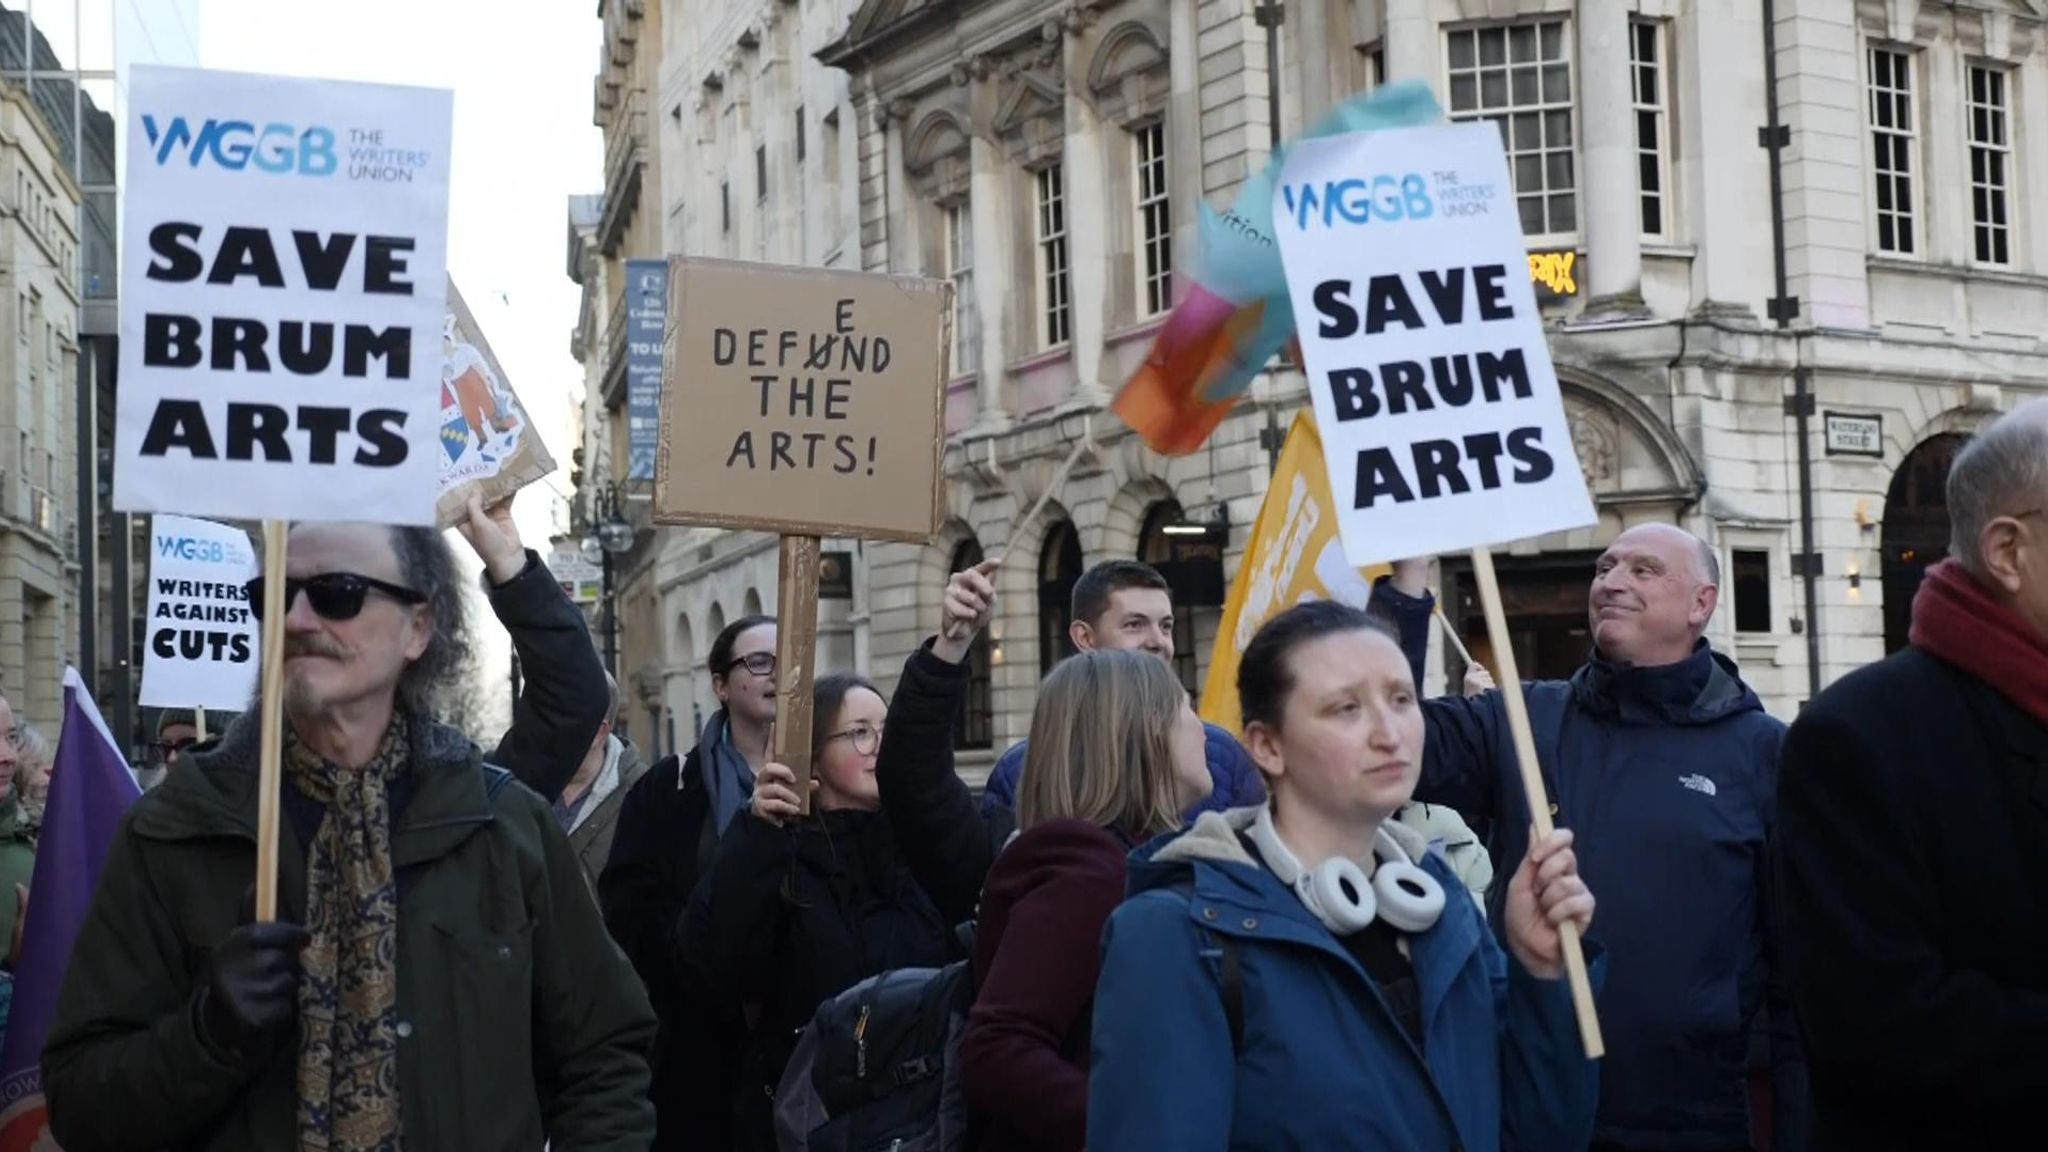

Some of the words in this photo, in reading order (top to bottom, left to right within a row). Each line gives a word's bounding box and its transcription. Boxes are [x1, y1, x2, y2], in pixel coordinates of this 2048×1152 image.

[141, 115, 338, 176] WGGB
[350, 129, 384, 146] THE
[349, 166, 413, 183] UNION
[1433, 171, 1457, 186] THE
[1284, 173, 1433, 230] WGGB
[1441, 200, 1488, 217] UNION
[146, 221, 415, 296] SAVE
[1312, 264, 1514, 339] SAVE
[143, 313, 411, 379] BRUM
[750, 376, 851, 419] THE
[1327, 348, 1533, 422] BRUM
[139, 398, 410, 468] ARTS
[726, 431, 876, 476] ARTS!
[1354, 426, 1554, 509] ARTS
[157, 535, 223, 562] WGGB
[157, 578, 249, 601] WRITERS
[155, 602, 249, 624] AGAINST
[152, 628, 251, 663] CUTS
